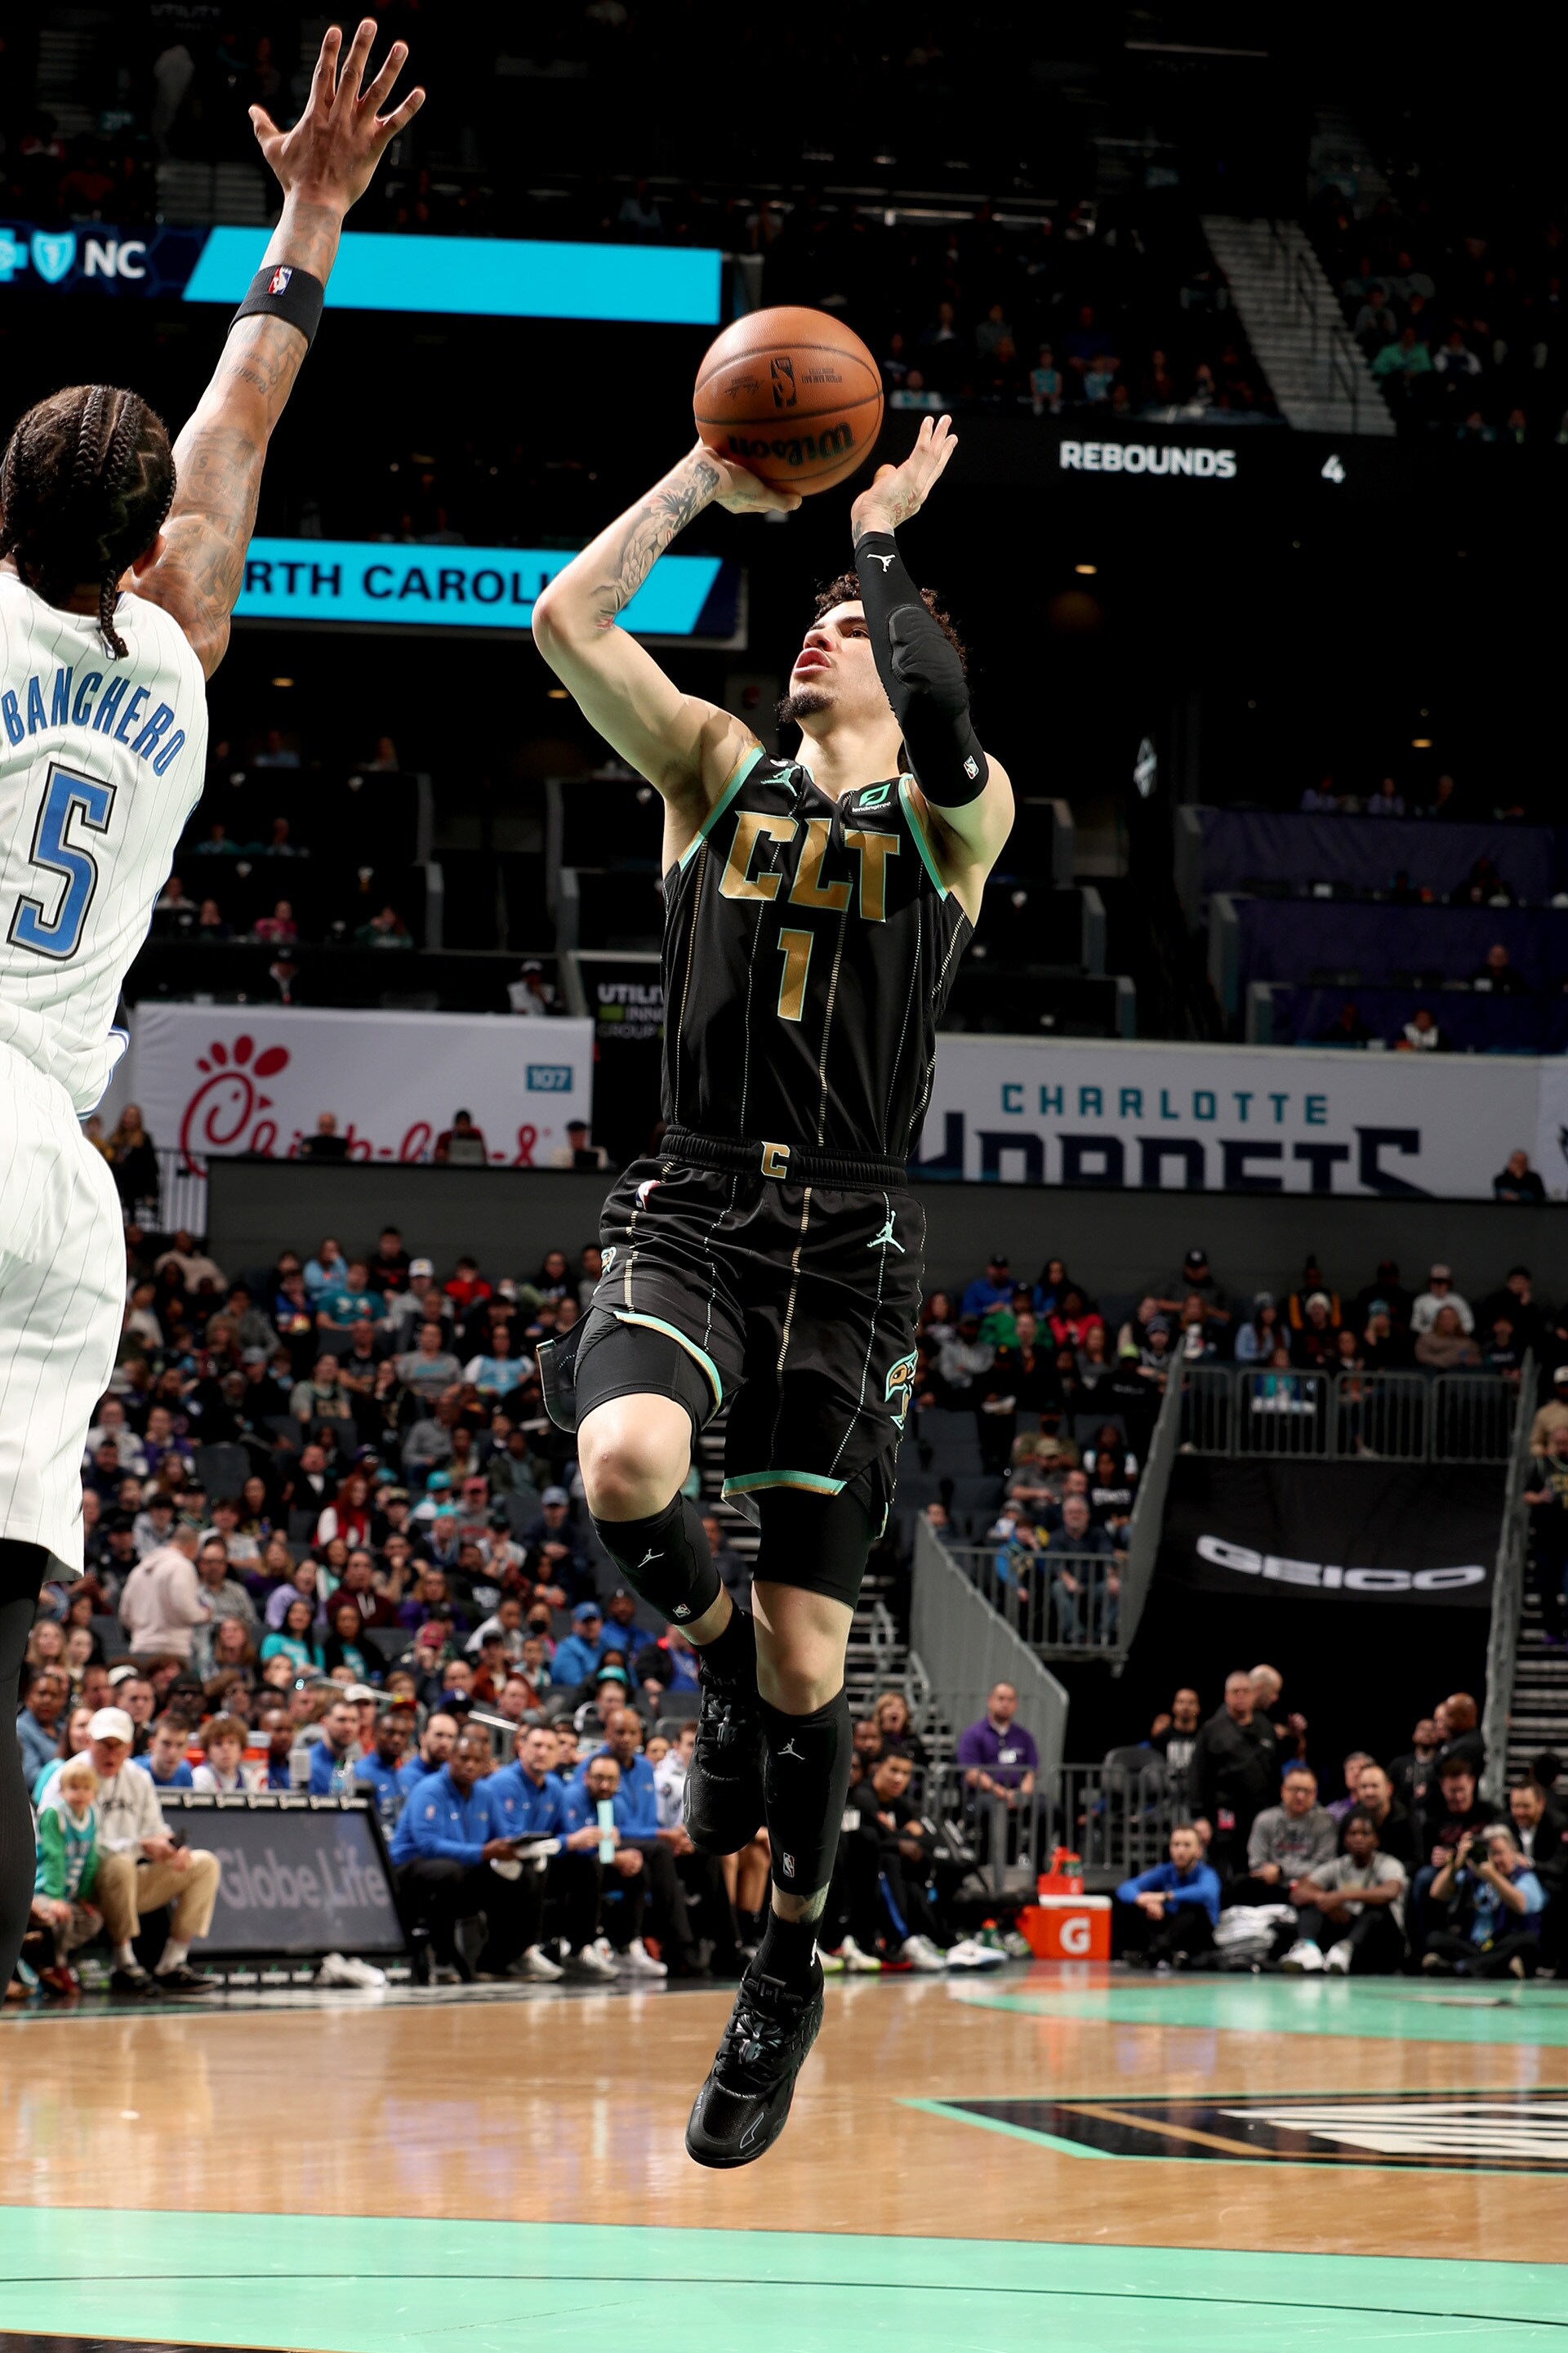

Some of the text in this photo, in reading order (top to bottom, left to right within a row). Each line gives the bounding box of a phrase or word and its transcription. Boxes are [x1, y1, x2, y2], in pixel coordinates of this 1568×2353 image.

[84, 239, 145, 279] NC
[728, 422, 856, 466] Wilson
[1060, 441, 1345, 484] REBOUNDS 4
[246, 560, 550, 605] RTH CAROLI
[1, 666, 185, 777] BANCHERO
[852, 801, 892, 813] lendingtree
[7, 761, 118, 962] 5
[719, 810, 900, 923] CLT
[777, 928, 814, 1022] 1
[530, 1068, 570, 1089] 107
[1001, 1083, 1329, 1124] CHARLOTTE
[761, 1141, 790, 1179] C
[1196, 1535, 1486, 1591] GEICO
[216, 1843, 390, 1910] Globe Life
[1059, 1916, 1091, 1954] G
